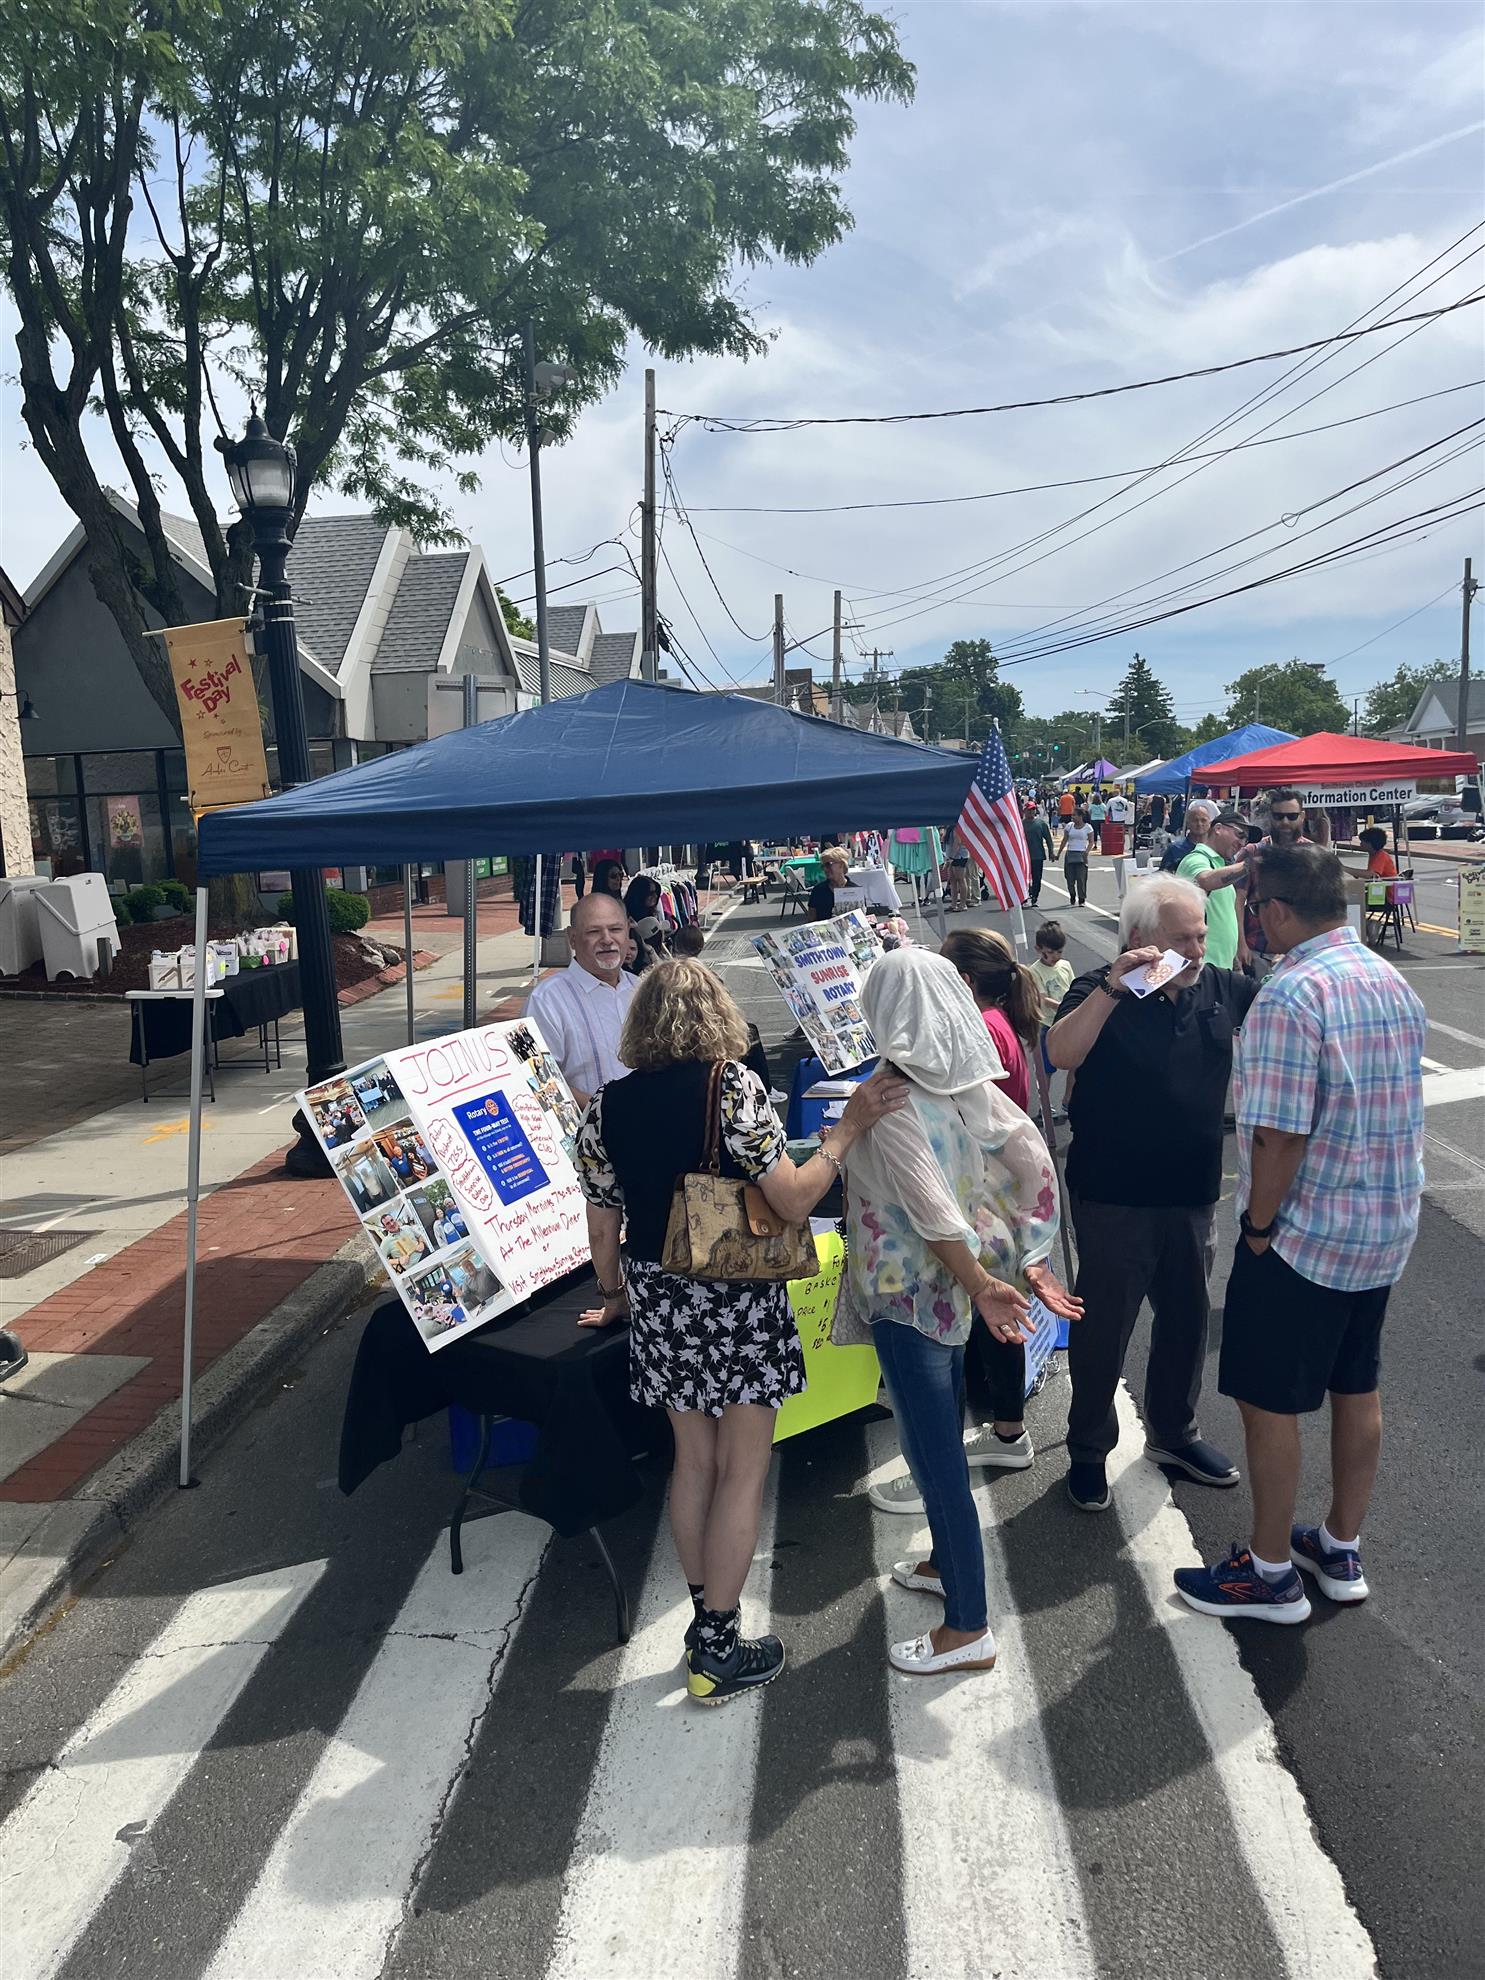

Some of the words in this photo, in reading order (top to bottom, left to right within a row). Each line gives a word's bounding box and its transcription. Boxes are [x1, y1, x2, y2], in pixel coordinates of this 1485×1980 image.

[180, 653, 242, 701] Festival
[202, 686, 230, 713] Day
[1303, 789, 1367, 804] nformation
[1369, 788, 1412, 801] Center
[794, 946, 847, 968] SMITHTOWN
[810, 964, 849, 985] SUNRISE
[822, 981, 857, 1002] ROTARY
[466, 1107, 488, 1120] Rotary
[484, 1210, 529, 1238] Thursday
[499, 1243, 514, 1262] At
[515, 1235, 533, 1250] The
[559, 1212, 581, 1230] Diner
[542, 1242, 550, 1252] or
[508, 1274, 528, 1295] Visit
[805, 1272, 841, 1294] BASKE
